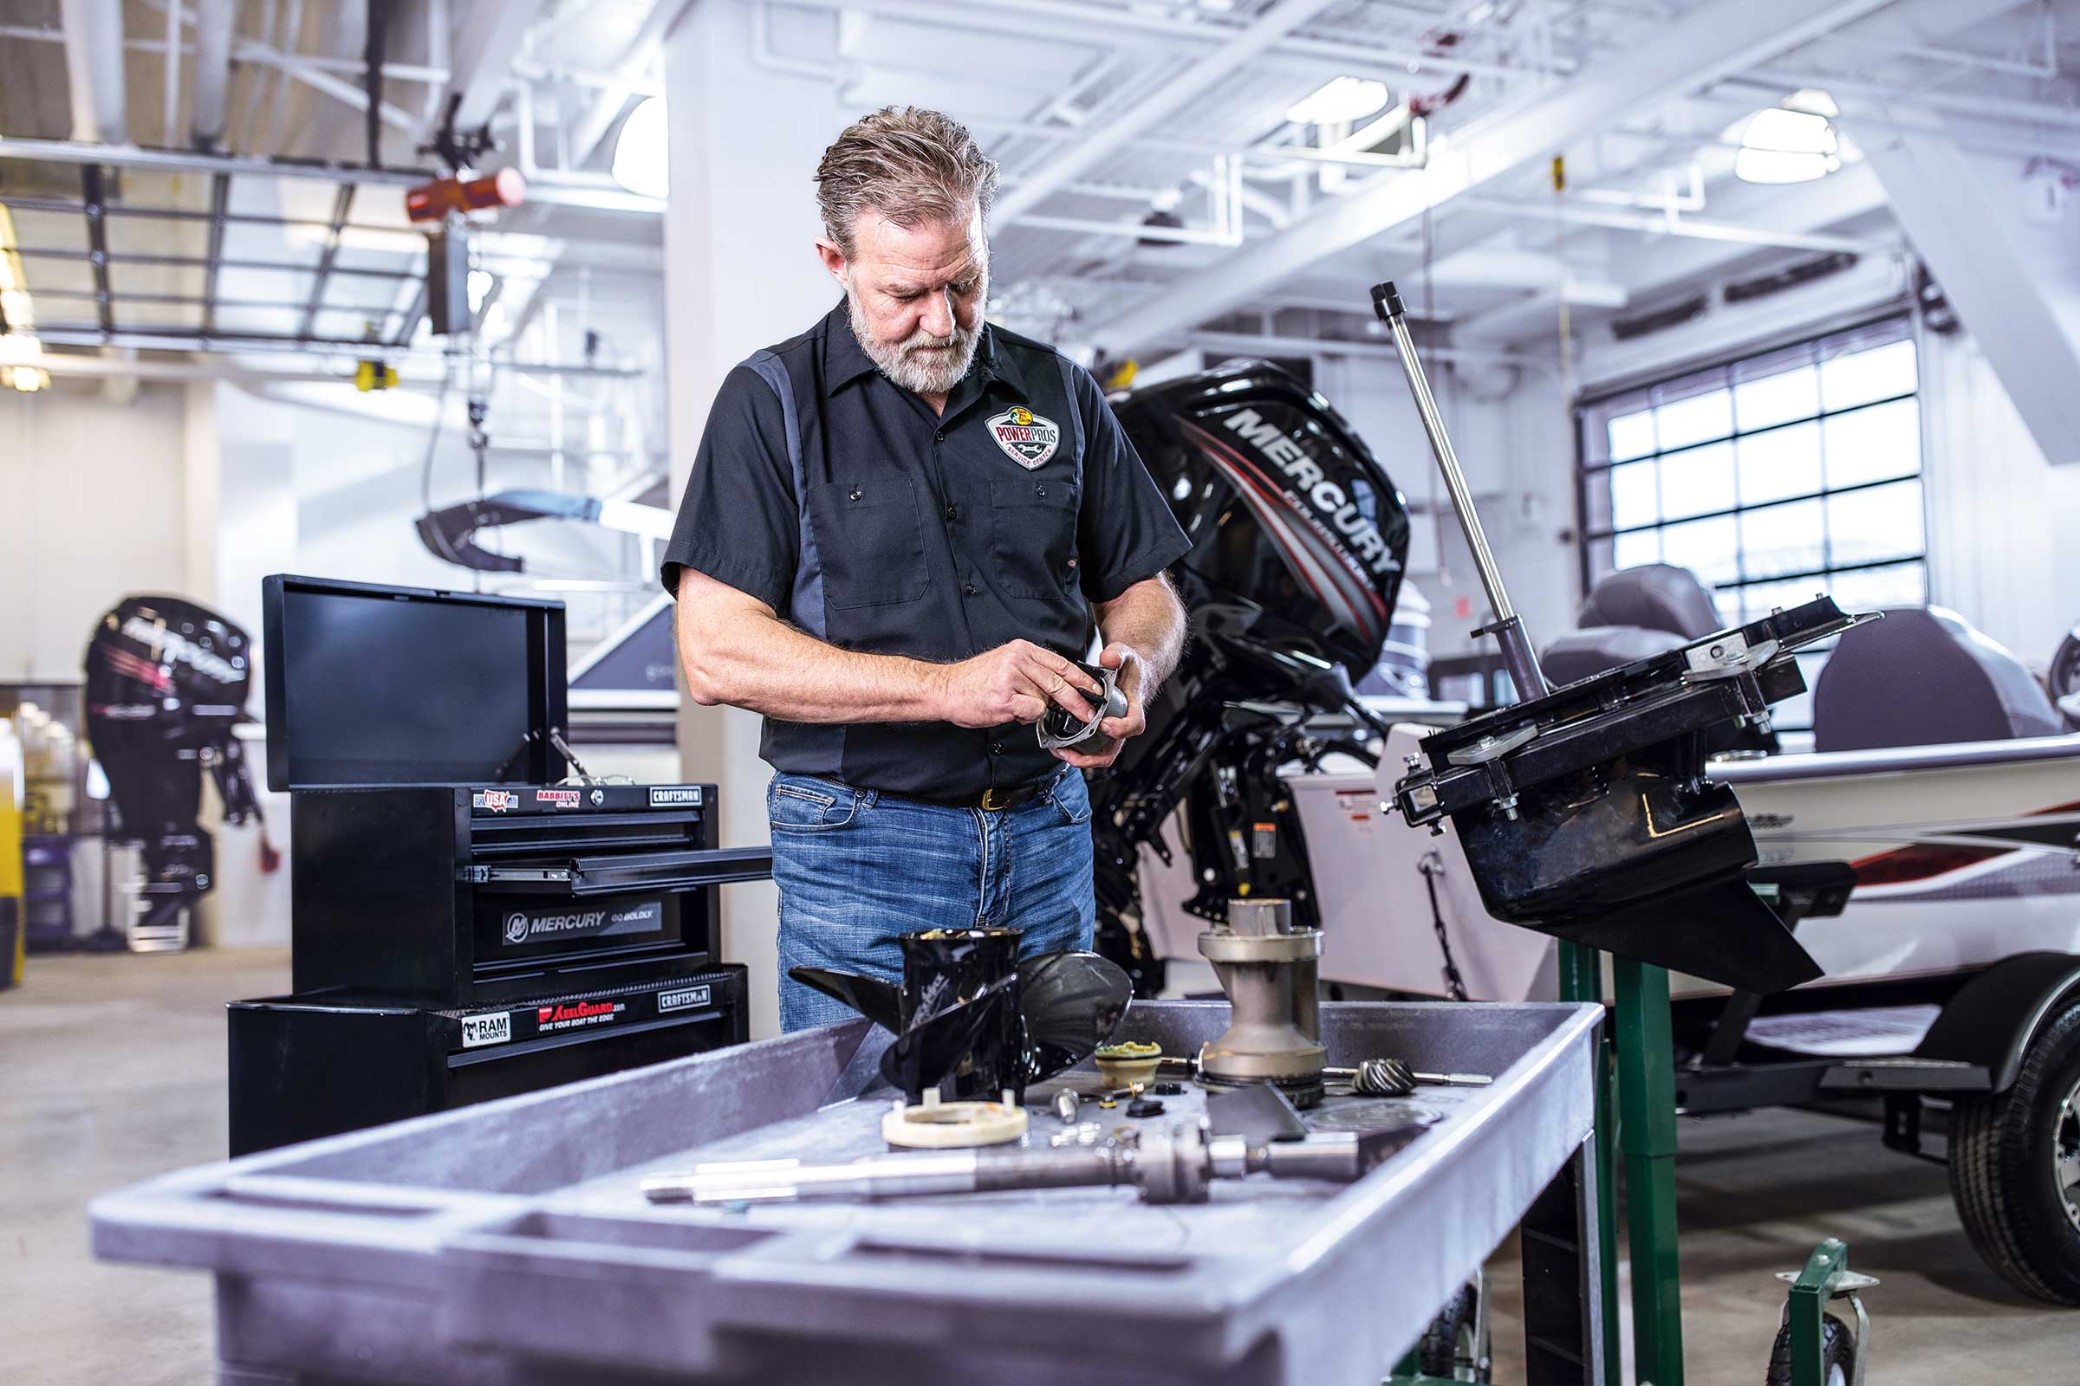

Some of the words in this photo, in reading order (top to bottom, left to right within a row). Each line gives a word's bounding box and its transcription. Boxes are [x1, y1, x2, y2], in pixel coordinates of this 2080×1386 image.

[1223, 408, 1401, 574] MERCURY
[485, 793, 506, 806] USA
[653, 790, 699, 802] CRAFTSMAN
[530, 911, 606, 934] MERCURY
[611, 914, 623, 922] GO
[479, 1017, 507, 1032] RAM
[539, 1022, 554, 1032] GIVE
[554, 1019, 571, 1029] YOUR
[571, 1017, 587, 1027] BOAT
[586, 1015, 598, 1024] THE
[598, 1012, 615, 1022] EDGE
[479, 1030, 508, 1041] MOUNTS
